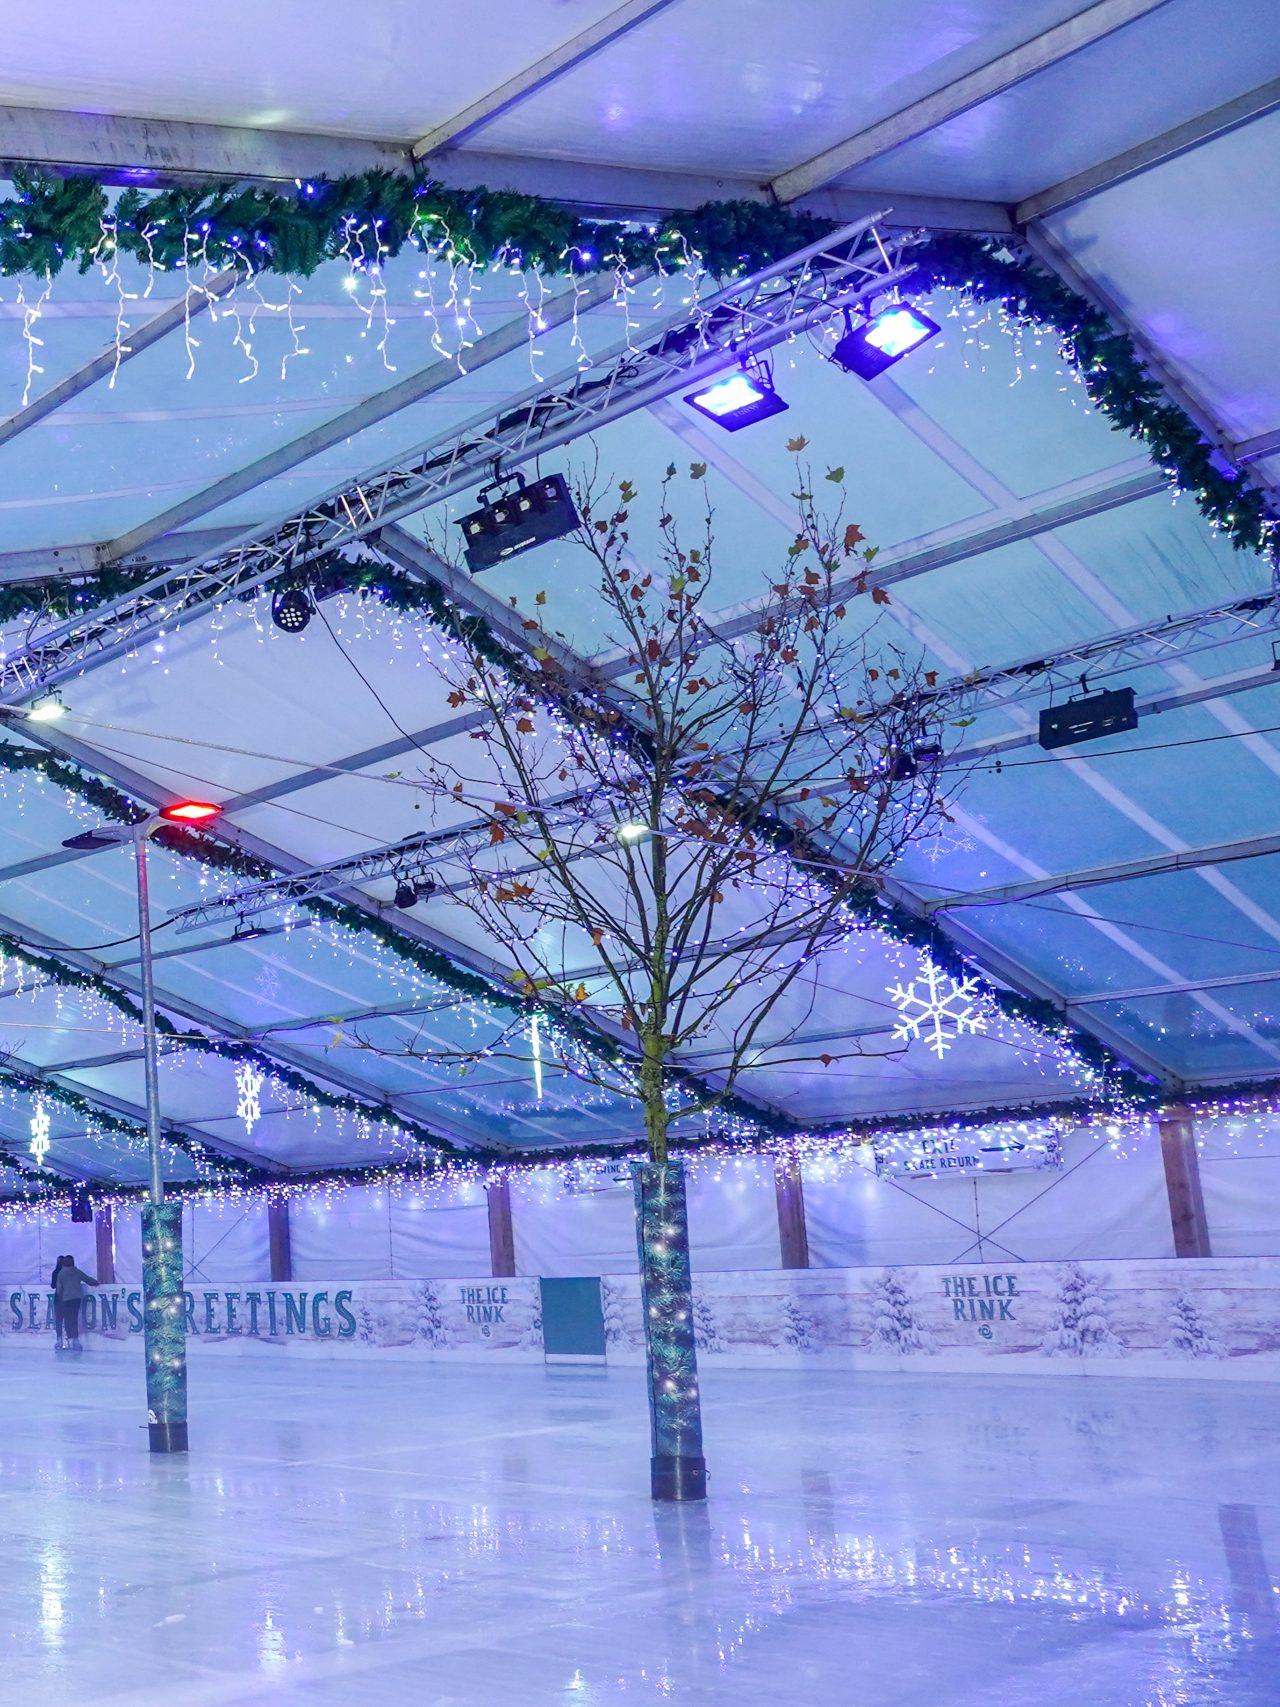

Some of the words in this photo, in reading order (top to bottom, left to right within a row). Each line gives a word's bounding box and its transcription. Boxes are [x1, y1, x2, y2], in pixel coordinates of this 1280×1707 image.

[459, 1287, 484, 1305] THE
[486, 1286, 509, 1305] ICE
[941, 1276, 980, 1297] THE
[983, 1274, 1021, 1297] ICE
[9, 1288, 144, 1333] SEAON'S
[183, 1290, 357, 1338] REETINGS
[465, 1304, 506, 1323] RINK
[952, 1298, 1017, 1322] RINK
